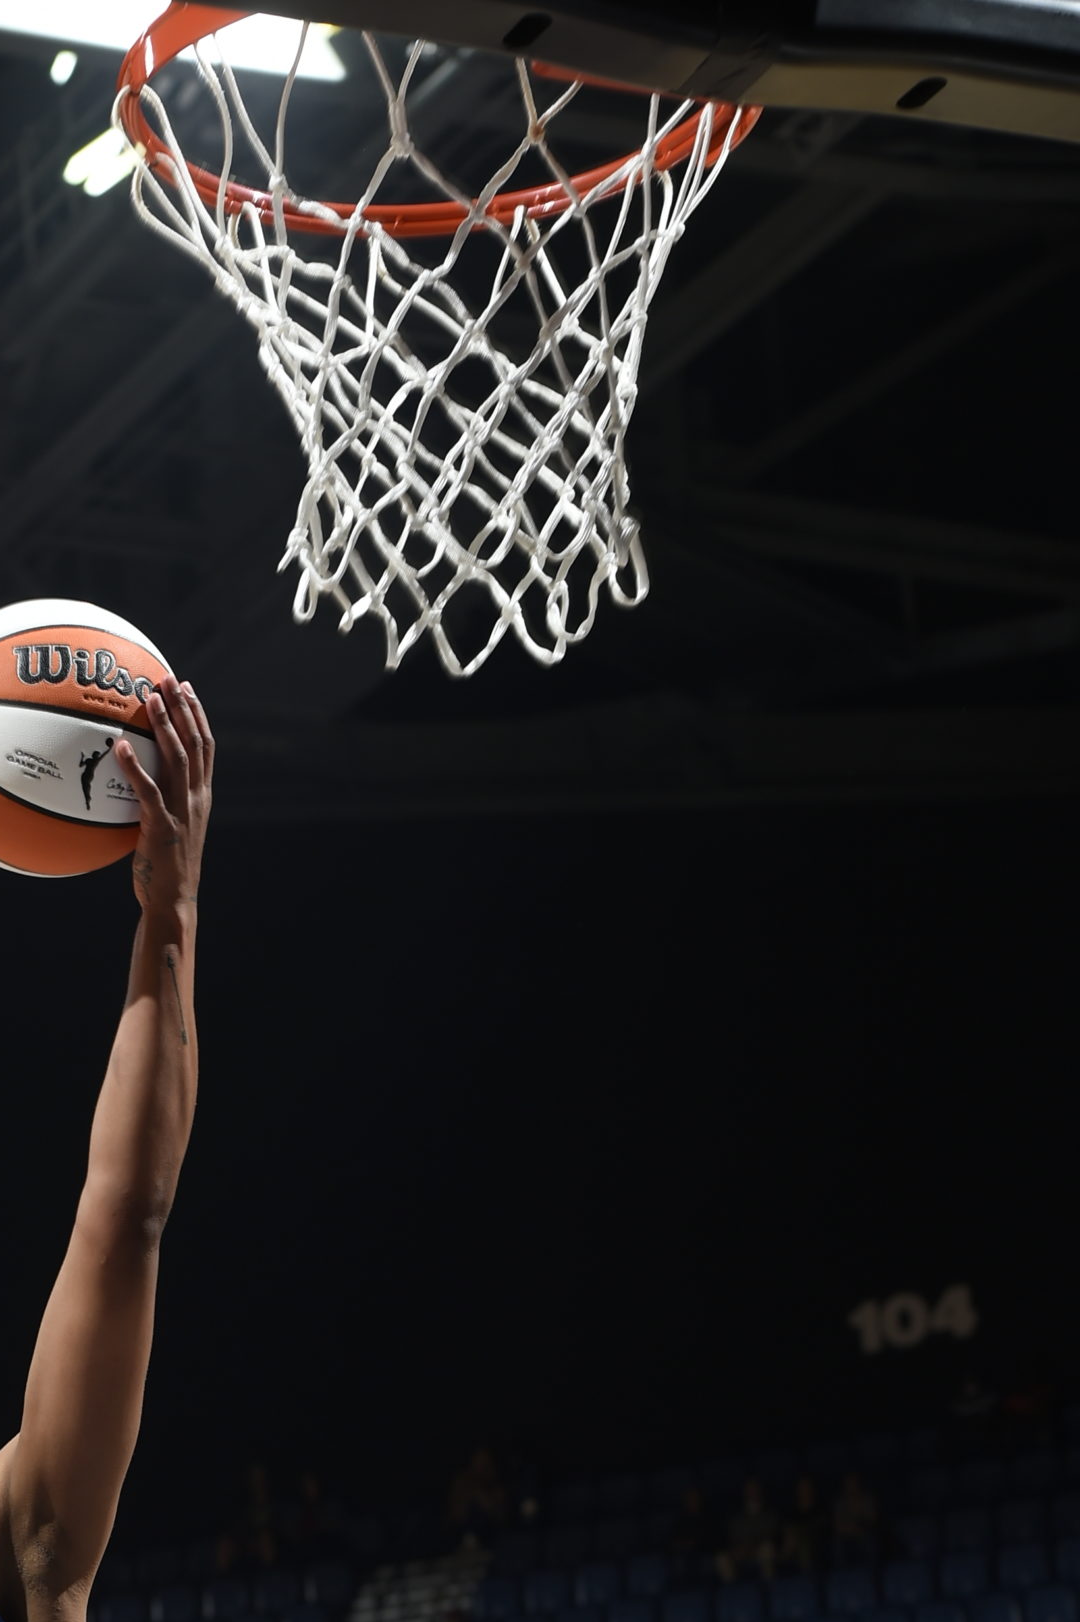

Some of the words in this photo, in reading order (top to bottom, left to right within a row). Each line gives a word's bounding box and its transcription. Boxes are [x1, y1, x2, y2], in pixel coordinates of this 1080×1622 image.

[13, 644, 163, 704] Wilso
[6, 755, 37, 771] GAME
[38, 767, 64, 780] BALL
[15, 749, 59, 770] OFFICIAL
[848, 1284, 978, 1353] 104
